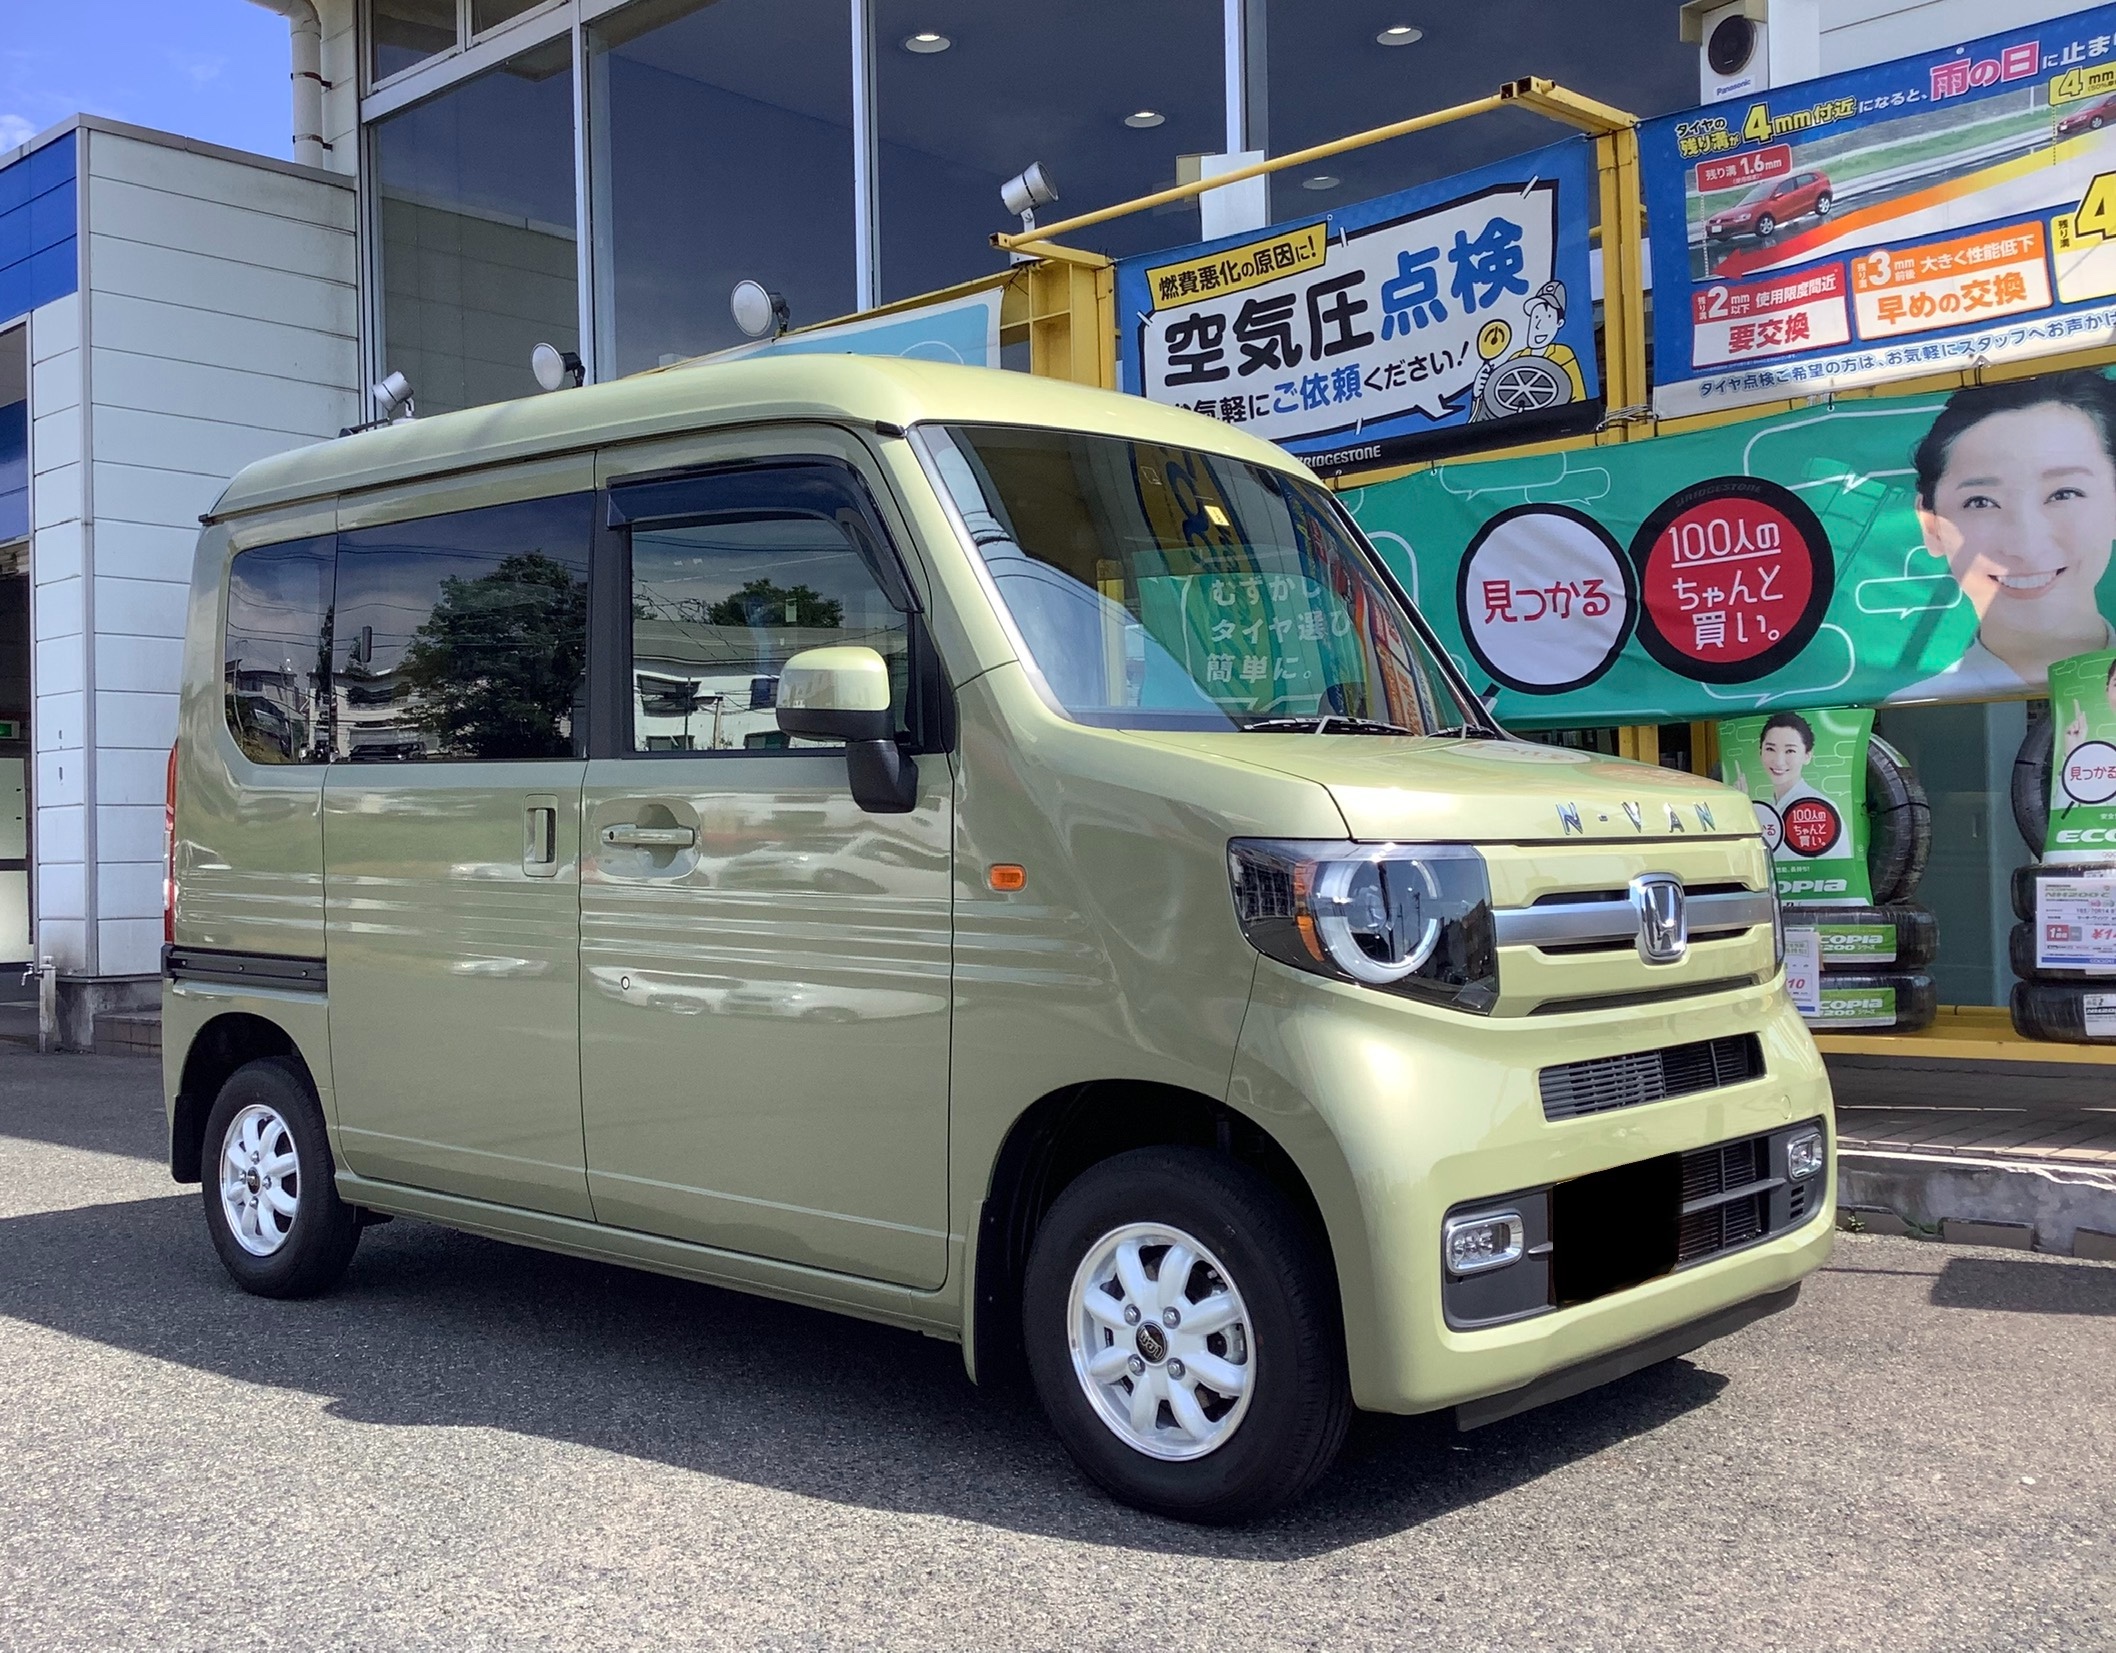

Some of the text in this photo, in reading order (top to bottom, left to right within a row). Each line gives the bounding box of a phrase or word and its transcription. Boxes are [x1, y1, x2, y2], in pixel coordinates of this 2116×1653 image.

[1716, 79, 1751, 96] Panasonic
[1676, 119, 1726, 136] タイヤの
[1705, 154, 1782, 181] 残り溝 1.6mm
[1868, 251, 1891, 286] 3
[1921, 234, 2035, 273] 大きく性能低下
[1164, 217, 1530, 387] 空気圧点検
[1708, 285, 1729, 318] 2
[1756, 274, 1836, 308] 使用限度間近
[1877, 272, 2027, 325] 早めの交換
[1728, 312, 1810, 353] 要交換
[1175, 341, 1470, 425] 気軽にご依頼ください!
[1668, 518, 1780, 562] 100人の
[1481, 579, 1612, 624] 見つかる
[1672, 565, 1784, 611] ちゃんと
[1692, 610, 1780, 650] 買い。
[1206, 653, 1312, 684] 簡単に。
[2070, 767, 2116, 781] 見つかる
[1556, 801, 1716, 835] N-VAN
[1793, 808, 1826, 821] 100人の
[1793, 824, 1826, 835] ちゃんと
[1786, 978, 1805, 989] 10
